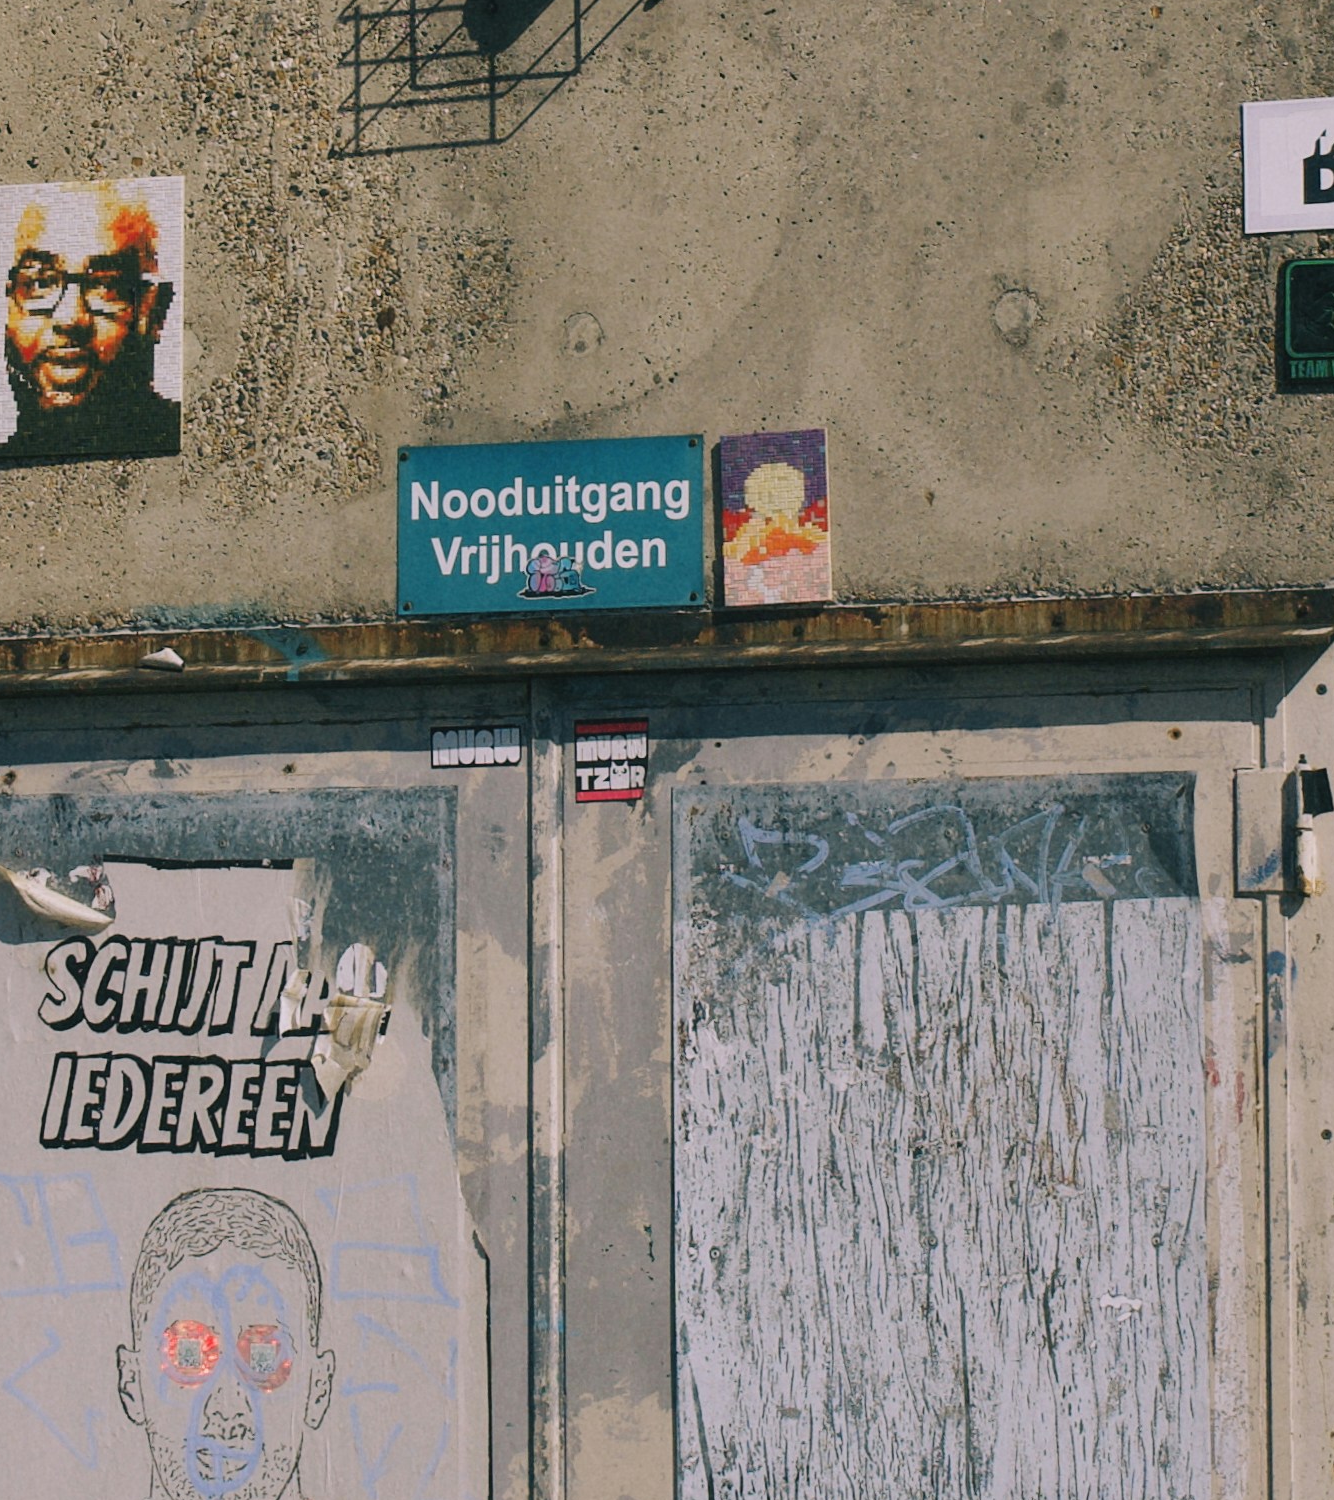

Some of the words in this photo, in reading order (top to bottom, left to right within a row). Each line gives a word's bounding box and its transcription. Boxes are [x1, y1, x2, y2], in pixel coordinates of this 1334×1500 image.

[1289, 359, 1328, 379] TEAM
[410, 475, 690, 523] Nooduitgang
[38, 934, 258, 1037] SCHIJT
[39, 1050, 348, 1161] IEDEREEN
